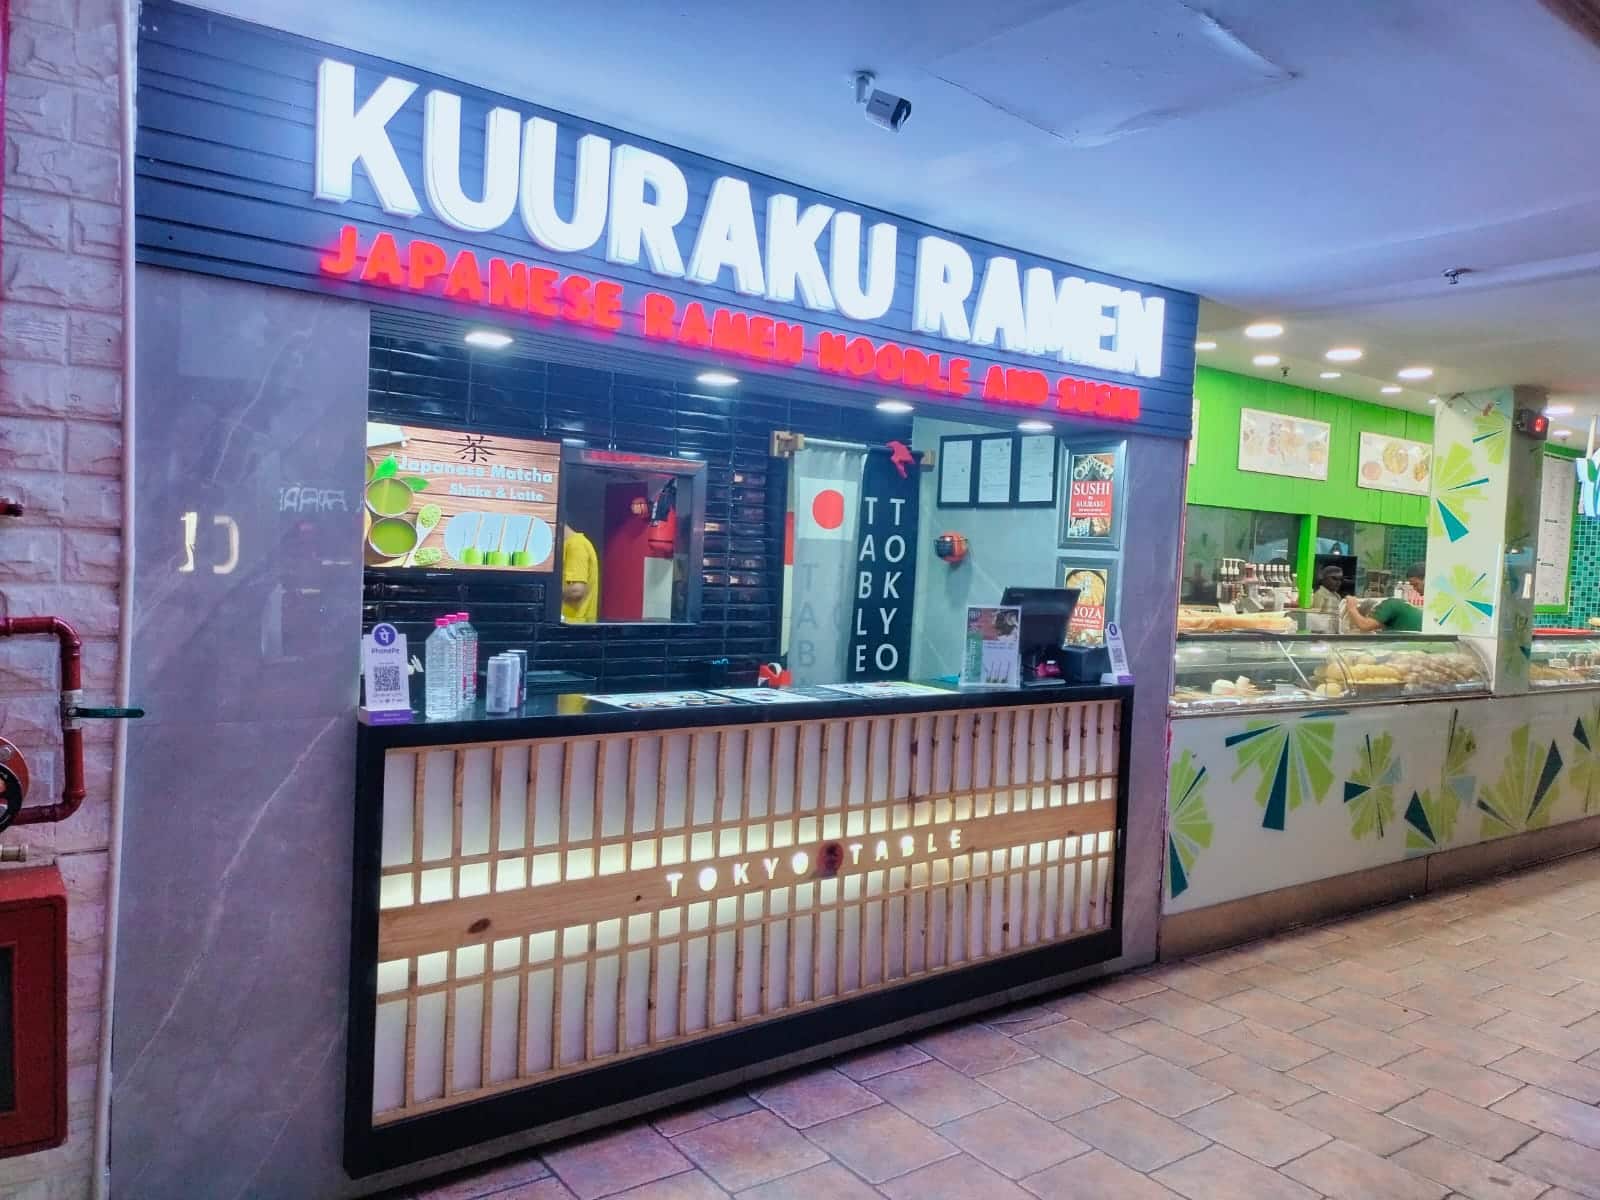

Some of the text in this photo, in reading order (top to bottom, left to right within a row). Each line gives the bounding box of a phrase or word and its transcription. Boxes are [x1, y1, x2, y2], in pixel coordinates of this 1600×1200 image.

[314, 59, 1165, 378] KUURAKU RAMEN
[320, 225, 1141, 420] JAPANESE RAMEN NOODLE AND SUSHI
[398, 456, 553, 483] Japanese Matcha
[455, 434, 497, 463] 茶
[449, 483, 493, 498] Shake
[510, 488, 545, 501] Latte
[1073, 482, 1110, 495] SUSHI
[854, 496, 879, 673] TABLE
[874, 497, 906, 672] TOKYO
[666, 828, 962, 898] TOKYO TABLE
